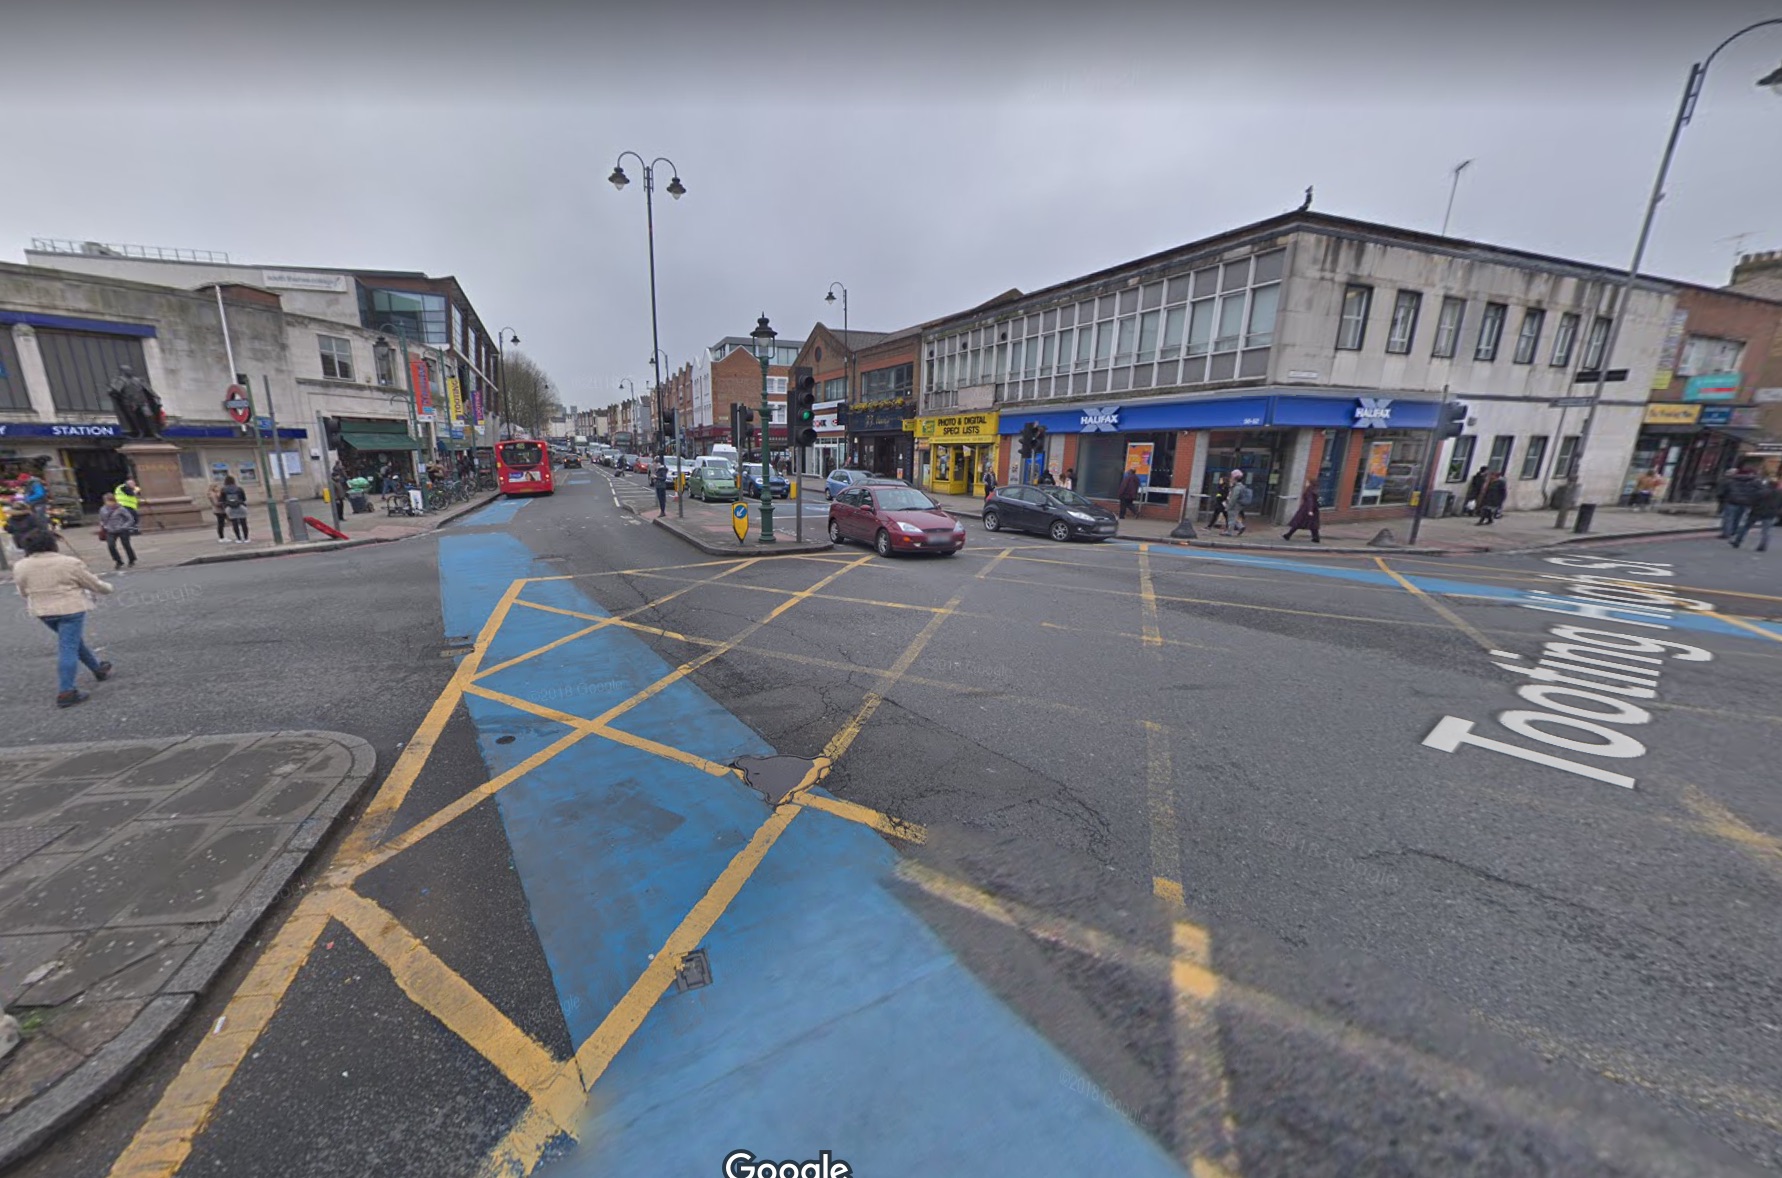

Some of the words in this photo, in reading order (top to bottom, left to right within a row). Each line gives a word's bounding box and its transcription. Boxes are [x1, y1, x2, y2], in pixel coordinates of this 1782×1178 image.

[452, 380, 462, 413] TOOTING
[1354, 407, 1392, 419] HALIFAX
[937, 418, 955, 427] PHOTO
[964, 415, 987, 425] DIGITAL
[1080, 414, 1119, 425] HALIFAX
[52, 425, 114, 436] STATION
[1519, 574, 1716, 629] High
[1422, 624, 1714, 789] Tooting
